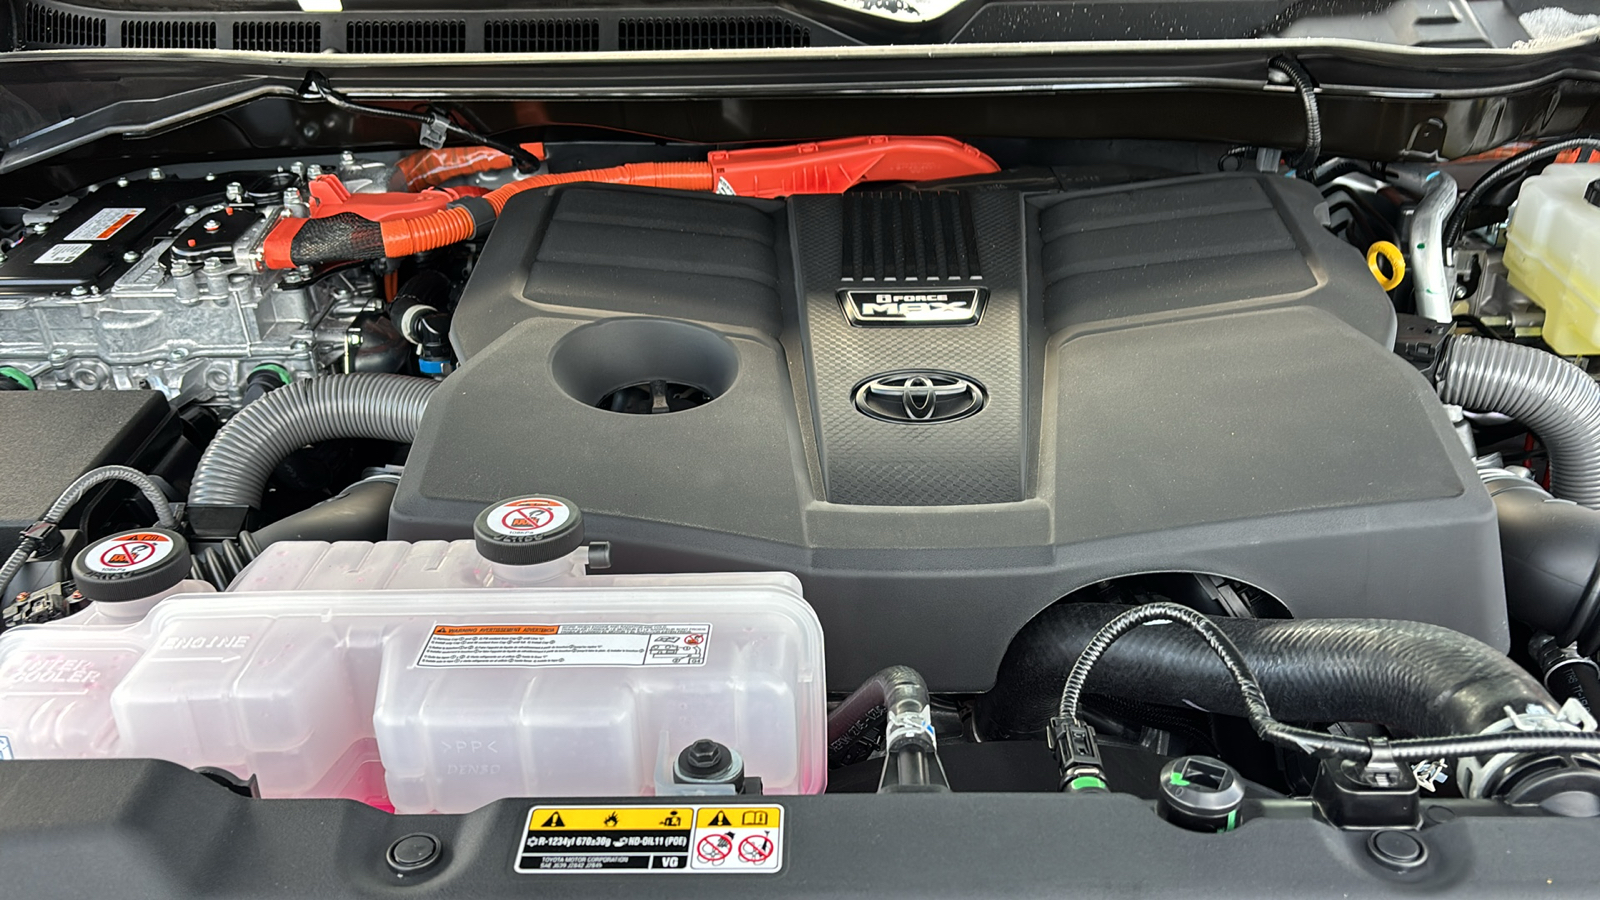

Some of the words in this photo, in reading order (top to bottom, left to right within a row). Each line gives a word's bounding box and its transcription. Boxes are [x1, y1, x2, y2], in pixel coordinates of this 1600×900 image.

[160, 635, 250, 650] ENGINE
[447, 764, 500, 775] DENSO
[665, 836, 687, 847] (POE)
[662, 856, 679, 868] VG
